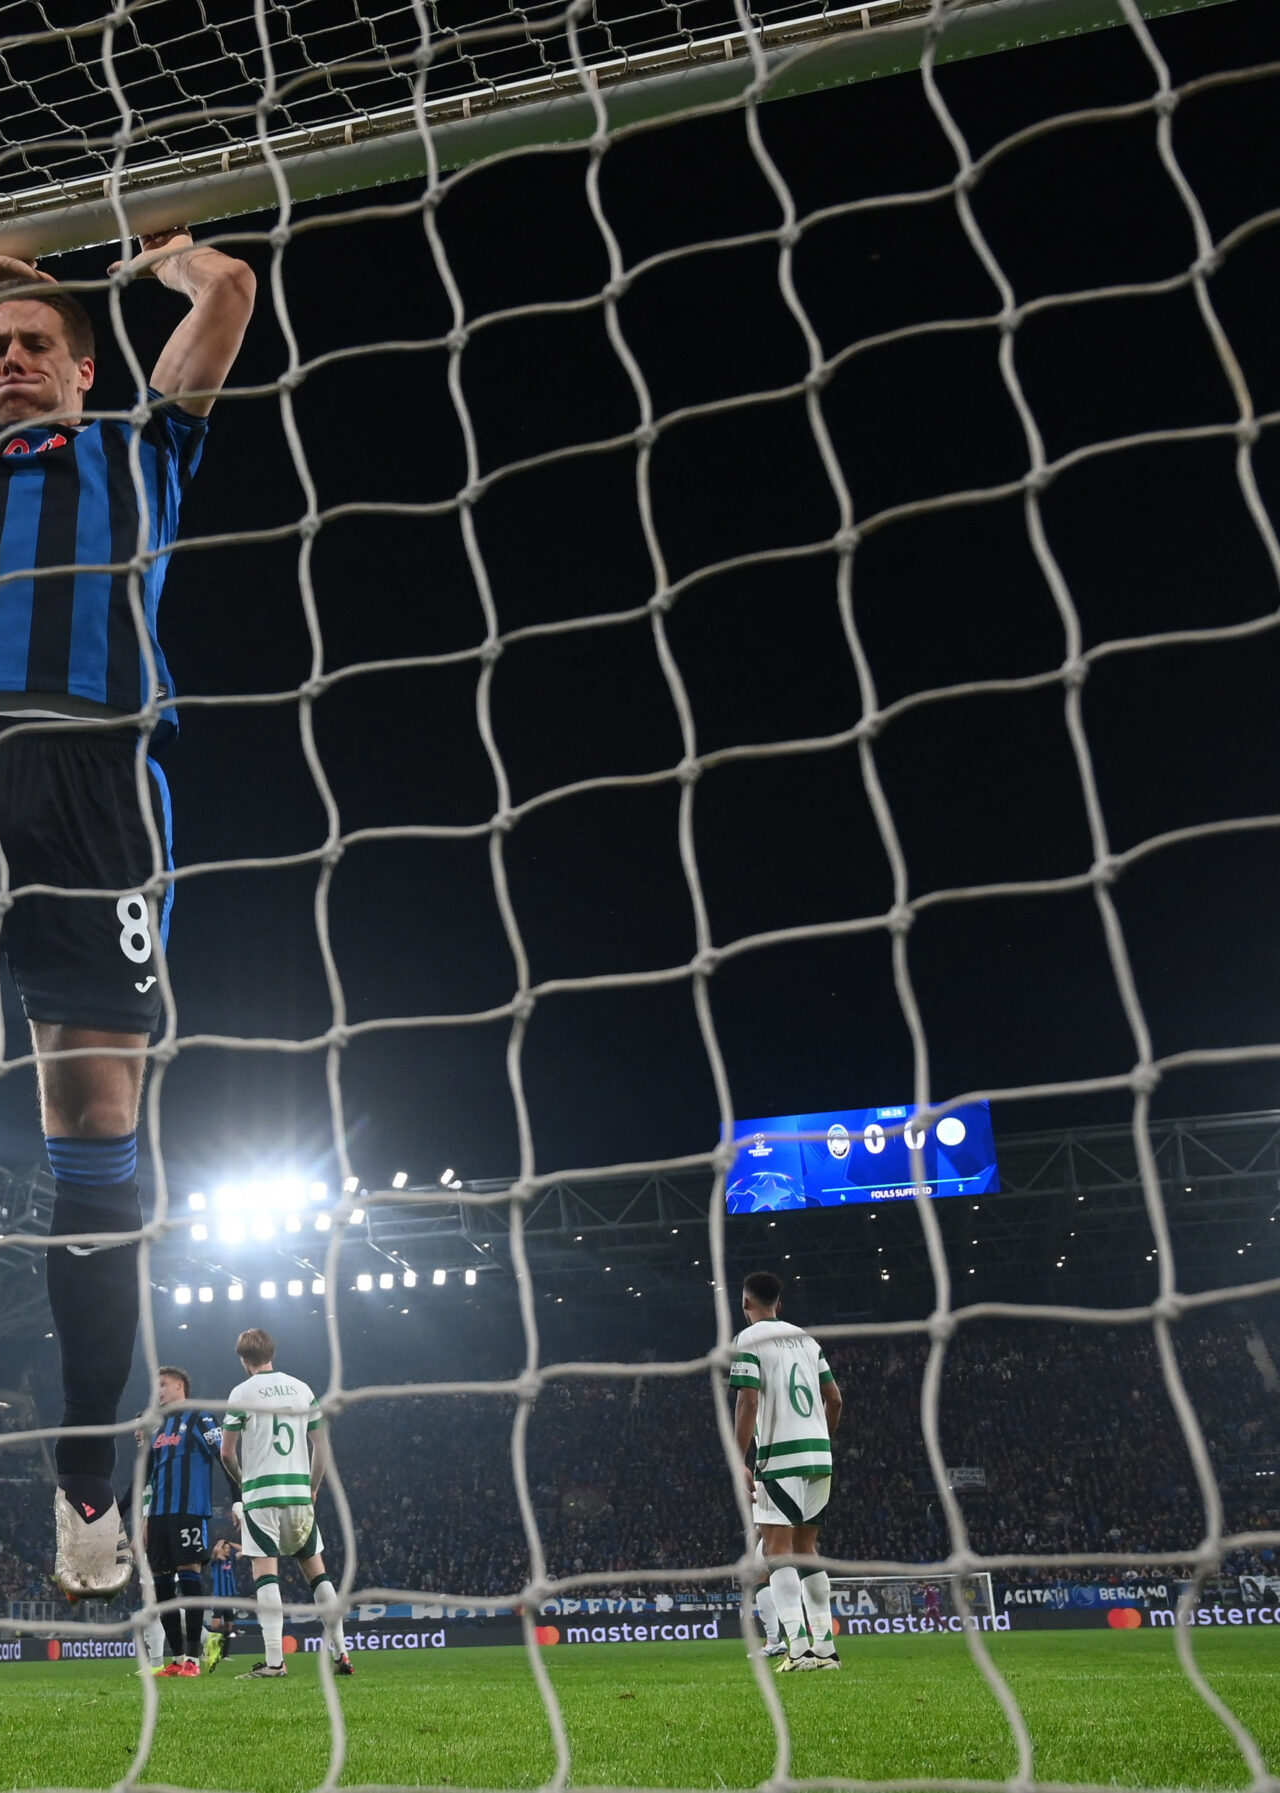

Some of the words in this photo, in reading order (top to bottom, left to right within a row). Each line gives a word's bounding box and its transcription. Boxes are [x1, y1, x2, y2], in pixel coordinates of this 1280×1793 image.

[116, 892, 152, 963] 8
[863, 1124, 886, 1154] 0
[871, 1189, 895, 1199] FOULS
[895, 1187, 932, 1198] SUFFEED
[789, 1362, 814, 1418] 6
[272, 1406, 295, 1456] 5
[180, 1527, 202, 1547] 32
[1099, 1584, 1167, 1601] BERGAMO
[567, 1620, 719, 1643] mastercard
[62, 1639, 136, 1659] mastercard
